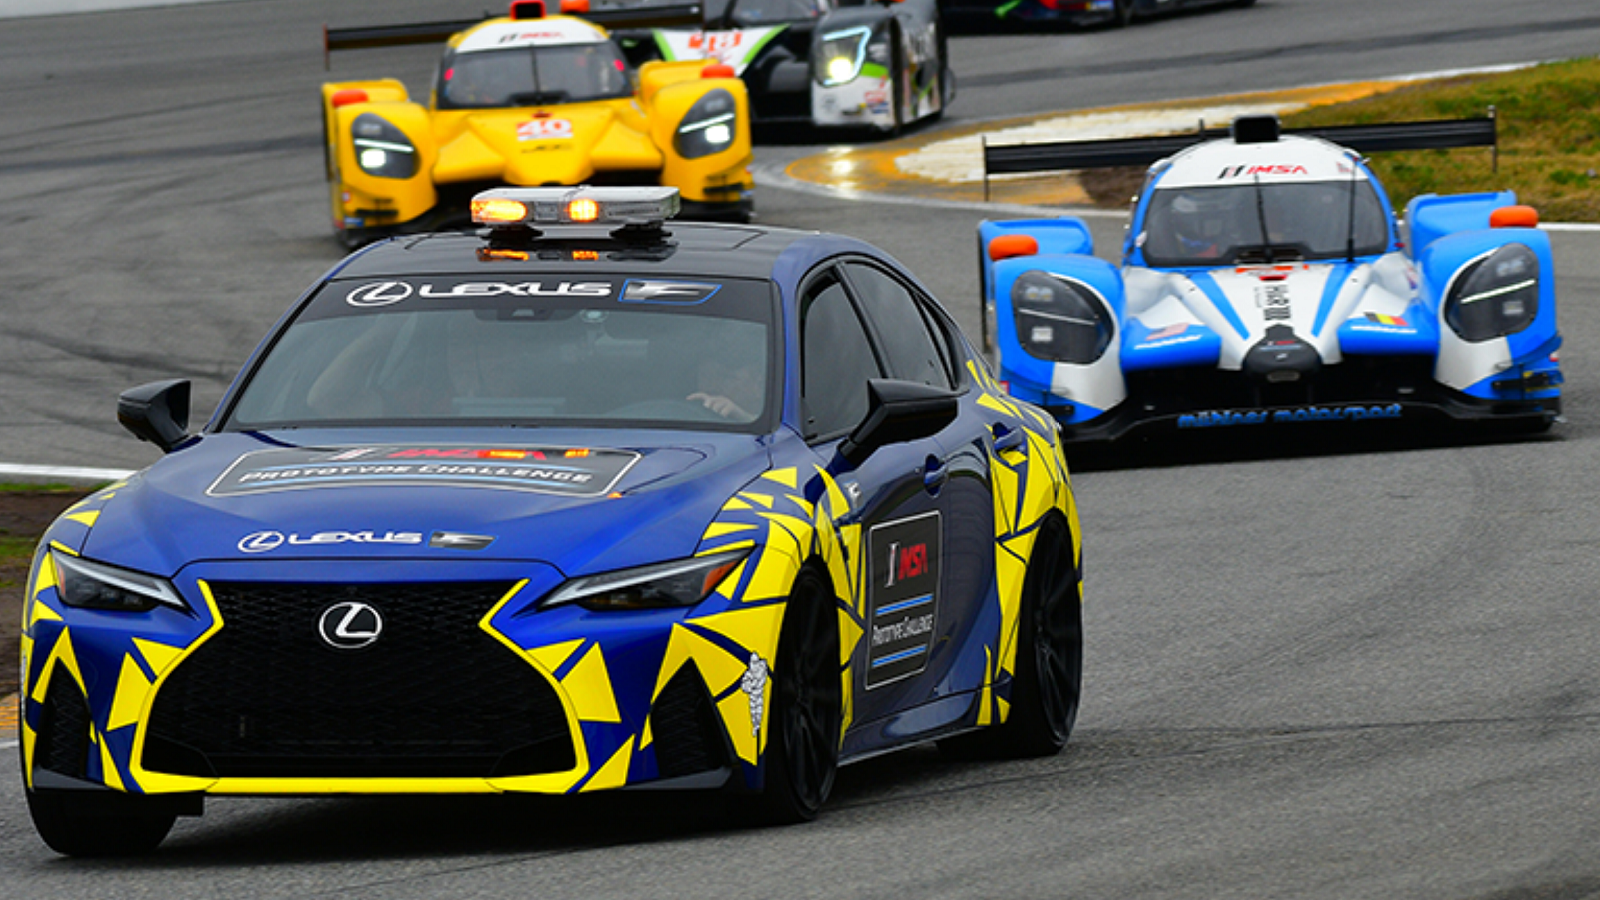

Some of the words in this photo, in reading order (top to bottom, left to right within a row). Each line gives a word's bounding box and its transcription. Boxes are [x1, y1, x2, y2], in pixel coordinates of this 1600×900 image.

[517, 120, 572, 138] 40
[1246, 165, 1308, 175] IMSA
[419, 282, 612, 298] LEXUS
[1273, 403, 1402, 422] motorsport
[238, 465, 413, 484] PROTOTYPE
[418, 464, 593, 483] CHALLENGE
[288, 531, 423, 545] LEXUS
